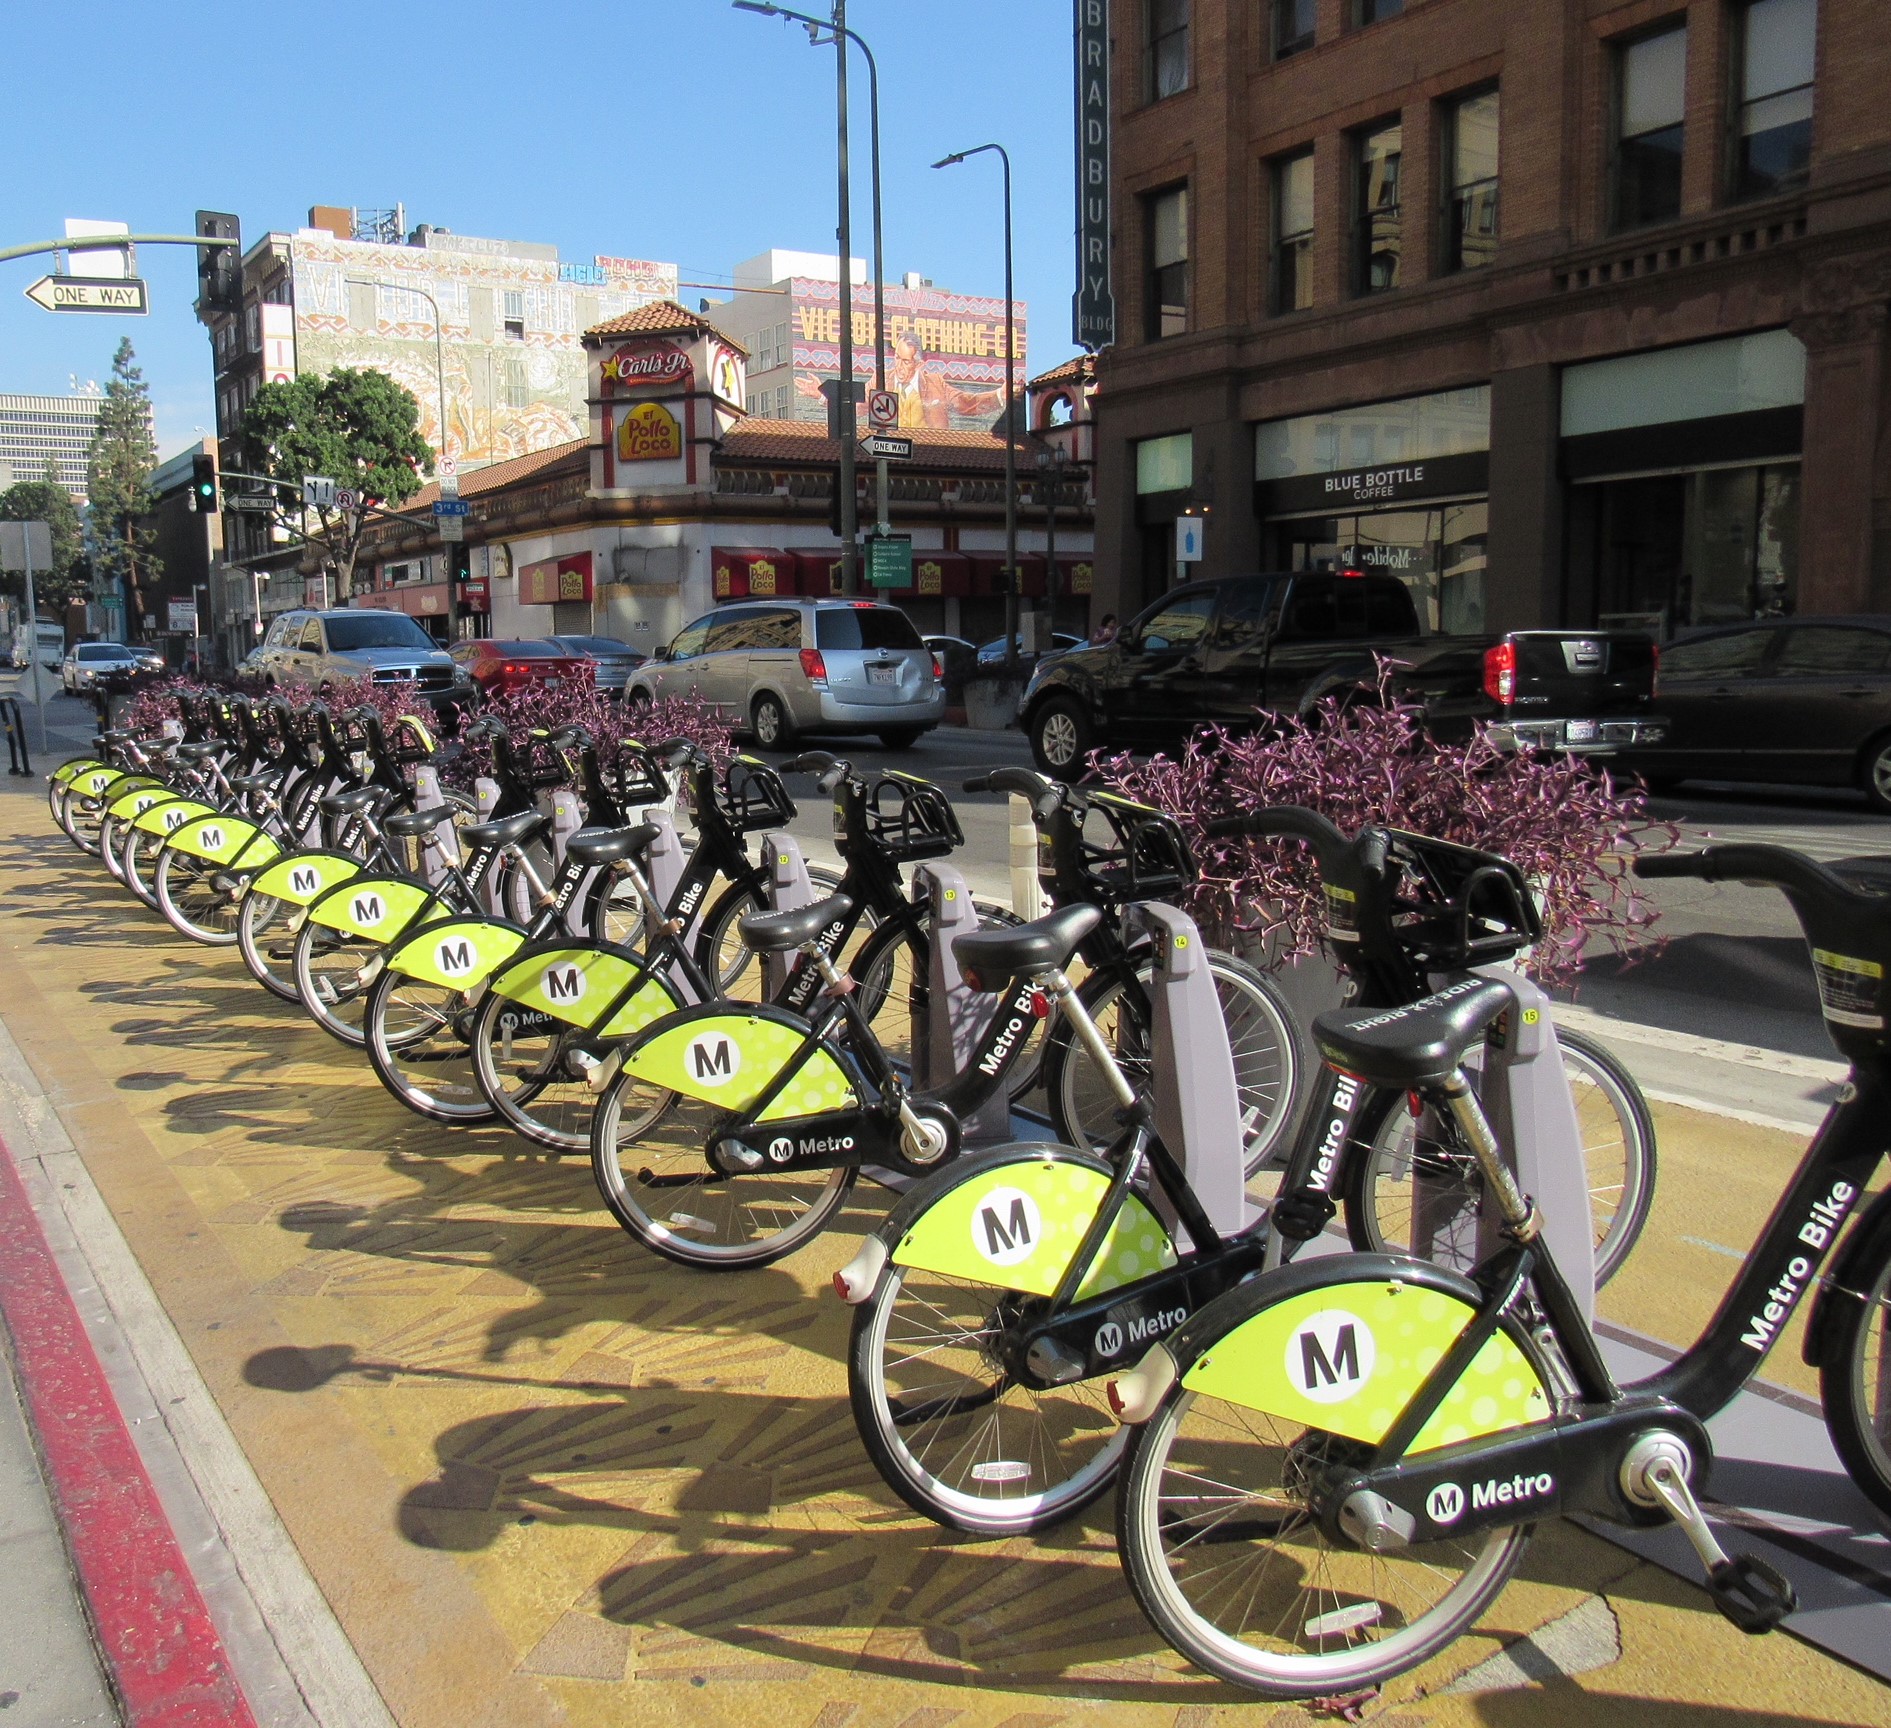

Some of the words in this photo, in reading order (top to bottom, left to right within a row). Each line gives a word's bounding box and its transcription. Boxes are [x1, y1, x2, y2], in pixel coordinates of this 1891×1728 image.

[1086, 1, 1103, 301] BRADBURY
[53, 286, 89, 303] ONE
[99, 287, 134, 305] WAY
[799, 306, 876, 346] VICO
[1081, 314, 1113, 331] BLDG
[617, 352, 662, 379] Carl's
[662, 351, 692, 374] Jr.
[643, 410, 654, 421] El
[628, 418, 670, 440] Pollo
[631, 436, 671, 455] Loco
[874, 442, 890, 451] ONE
[891, 444, 907, 453] WAY
[1325, 475, 1360, 492] BLUE
[1365, 467, 1424, 487] BOTTLE
[238, 499, 253, 507] ONE
[257, 500, 272, 508] WAY
[1353, 486, 1394, 500] COFFEE
[436, 503, 451, 513] 3rd
[455, 504, 466, 513] St
[562, 577, 581, 588] Pollo
[751, 568, 774, 581] Pollo
[752, 579, 774, 589] Loco
[920, 569, 940, 581] Pollo
[920, 580, 940, 590] Loco
[563, 586, 581, 596] Loco
[296, 804, 315, 831] Metro
[310, 784, 325, 804] Bike
[360, 800, 375, 815] ike
[166, 812, 183, 829] M
[202, 830, 220, 848] M
[293, 869, 316, 892] M
[466, 854, 488, 889] Metro
[554, 882, 574, 911] etro
[678, 882, 703, 915] Bike
[354, 897, 381, 922] M
[1176, 938, 1185, 946] 14
[441, 942, 471, 970] M
[548, 968, 580, 998] M
[788, 962, 818, 1006] Metr
[1434, 978, 1483, 1000] RIDE
[522, 1012, 553, 1026] Met
[1348, 1008, 1408, 1032] RIGHT
[1524, 1011, 1536, 1022] 15
[978, 1018, 1023, 1076] Metro
[1014, 982, 1045, 1014] Bik
[693, 1040, 731, 1078] M
[799, 1133, 854, 1155] Metro
[1306, 1119, 1344, 1193] Metro
[1332, 1075, 1359, 1112] Bi
[980, 1198, 1032, 1255] M
[1738, 1254, 1809, 1352] Metro
[1798, 1180, 1856, 1250] Bike
[1128, 1305, 1187, 1343] Metro
[1300, 1323, 1360, 1390] M
[1431, 1488, 1461, 1517] M
[1471, 1470, 1553, 1510] Metro
